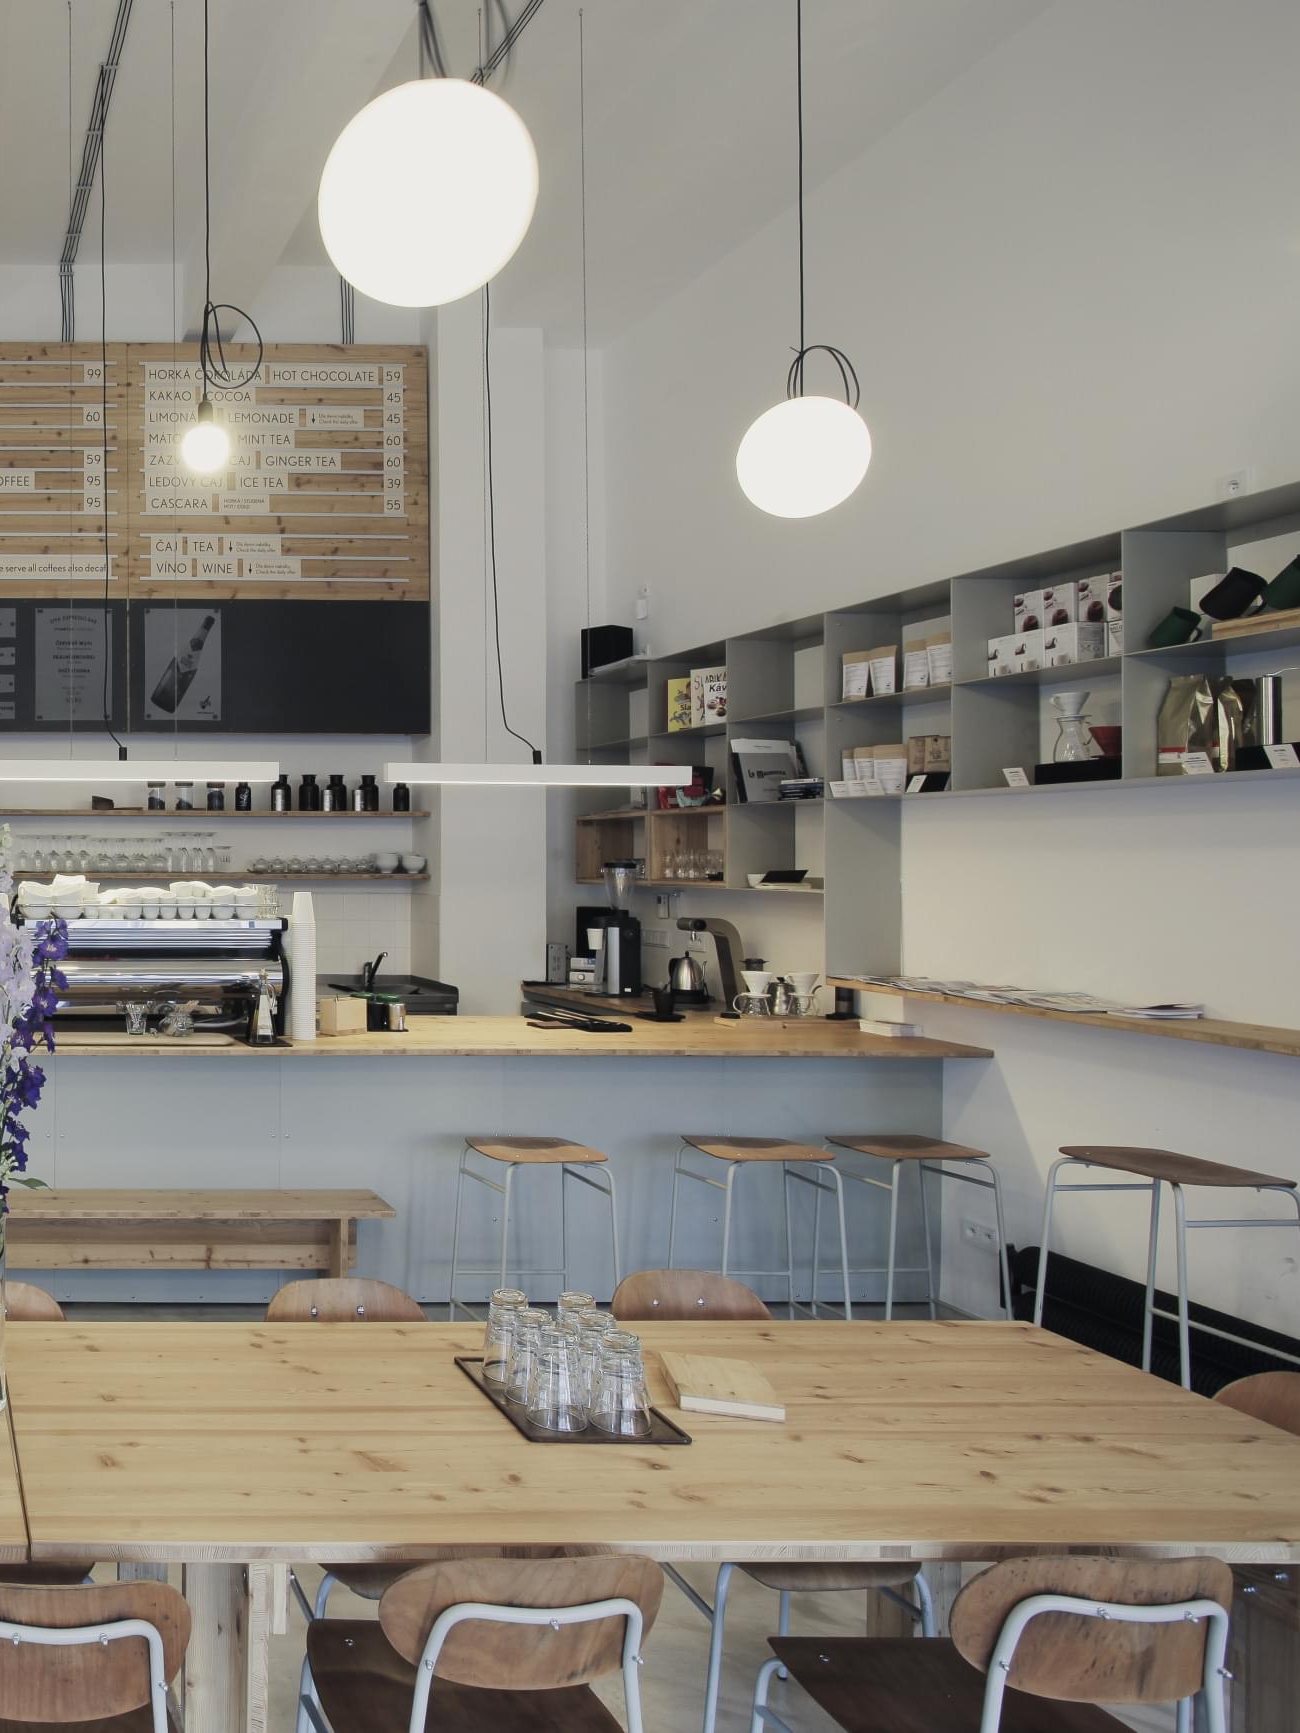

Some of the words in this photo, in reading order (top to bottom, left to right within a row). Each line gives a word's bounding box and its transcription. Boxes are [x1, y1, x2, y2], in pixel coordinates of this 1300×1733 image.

[87, 368, 101, 380] 99
[149, 367, 191, 380] HORKÁ
[273, 371, 297, 382] HOT
[300, 371, 375, 382] CHOCOLATE
[386, 371, 401, 382] 59
[149, 391, 192, 402] KAKAO
[206, 391, 252, 402] COCOA
[386, 392, 401, 403] 45
[86, 411, 101, 422] 60
[228, 412, 295, 424] LEMONADE
[386, 413, 401, 424] 45
[237, 434, 266, 445] MINT
[269, 434, 291, 445] TEA
[386, 435, 401, 446] 60
[86, 454, 101, 465] 59
[265, 456, 312, 467] GINGER
[315, 456, 336, 467] TEA
[386, 456, 401, 467] 60
[86, 475, 101, 486] 95
[240, 477, 259, 488] ICE
[261, 477, 284, 488] TEA
[387, 478, 401, 489] 39
[86, 497, 101, 508] 95
[151, 498, 208, 509] CASCARA
[386, 499, 401, 510] 55
[193, 541, 214, 552] TEA
[28, 563, 37, 572] all
[38, 563, 67, 572] coffees
[68, 563, 82, 572] also
[156, 560, 187, 574] VÍNO
[202, 562, 233, 574] WINE
